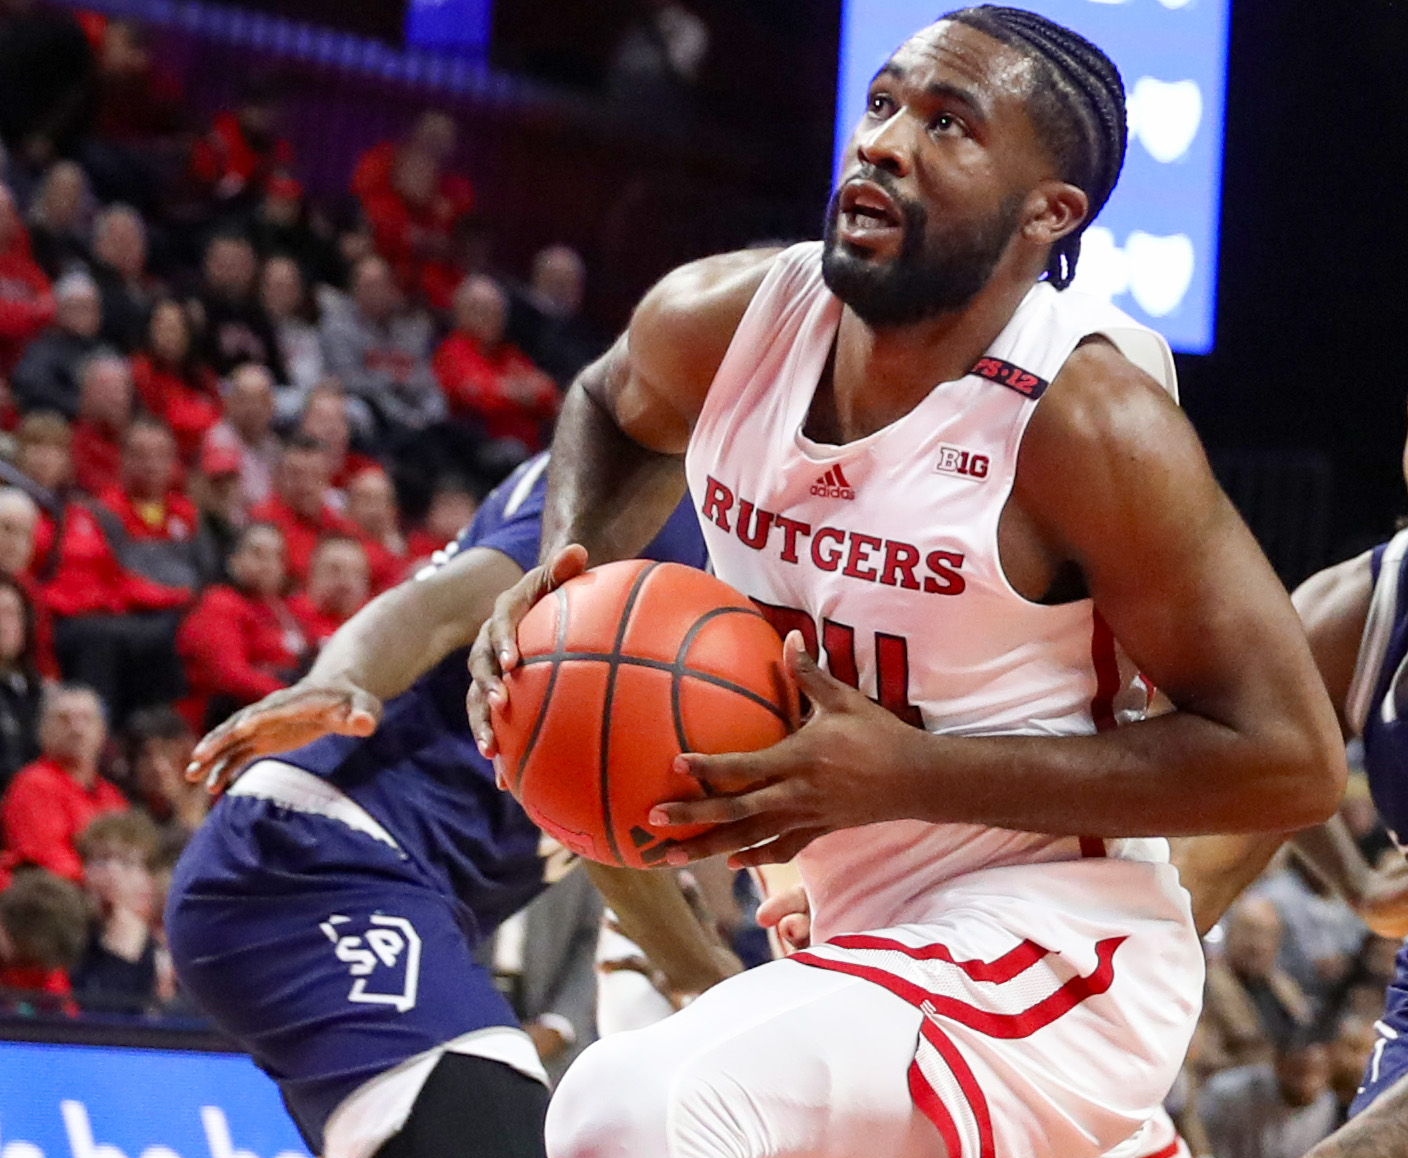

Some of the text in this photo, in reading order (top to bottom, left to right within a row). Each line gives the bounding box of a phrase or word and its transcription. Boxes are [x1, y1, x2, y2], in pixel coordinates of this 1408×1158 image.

[937, 446, 990, 479] B1G
[809, 484, 856, 501] adidas
[701, 475, 966, 596] RUTGERS
